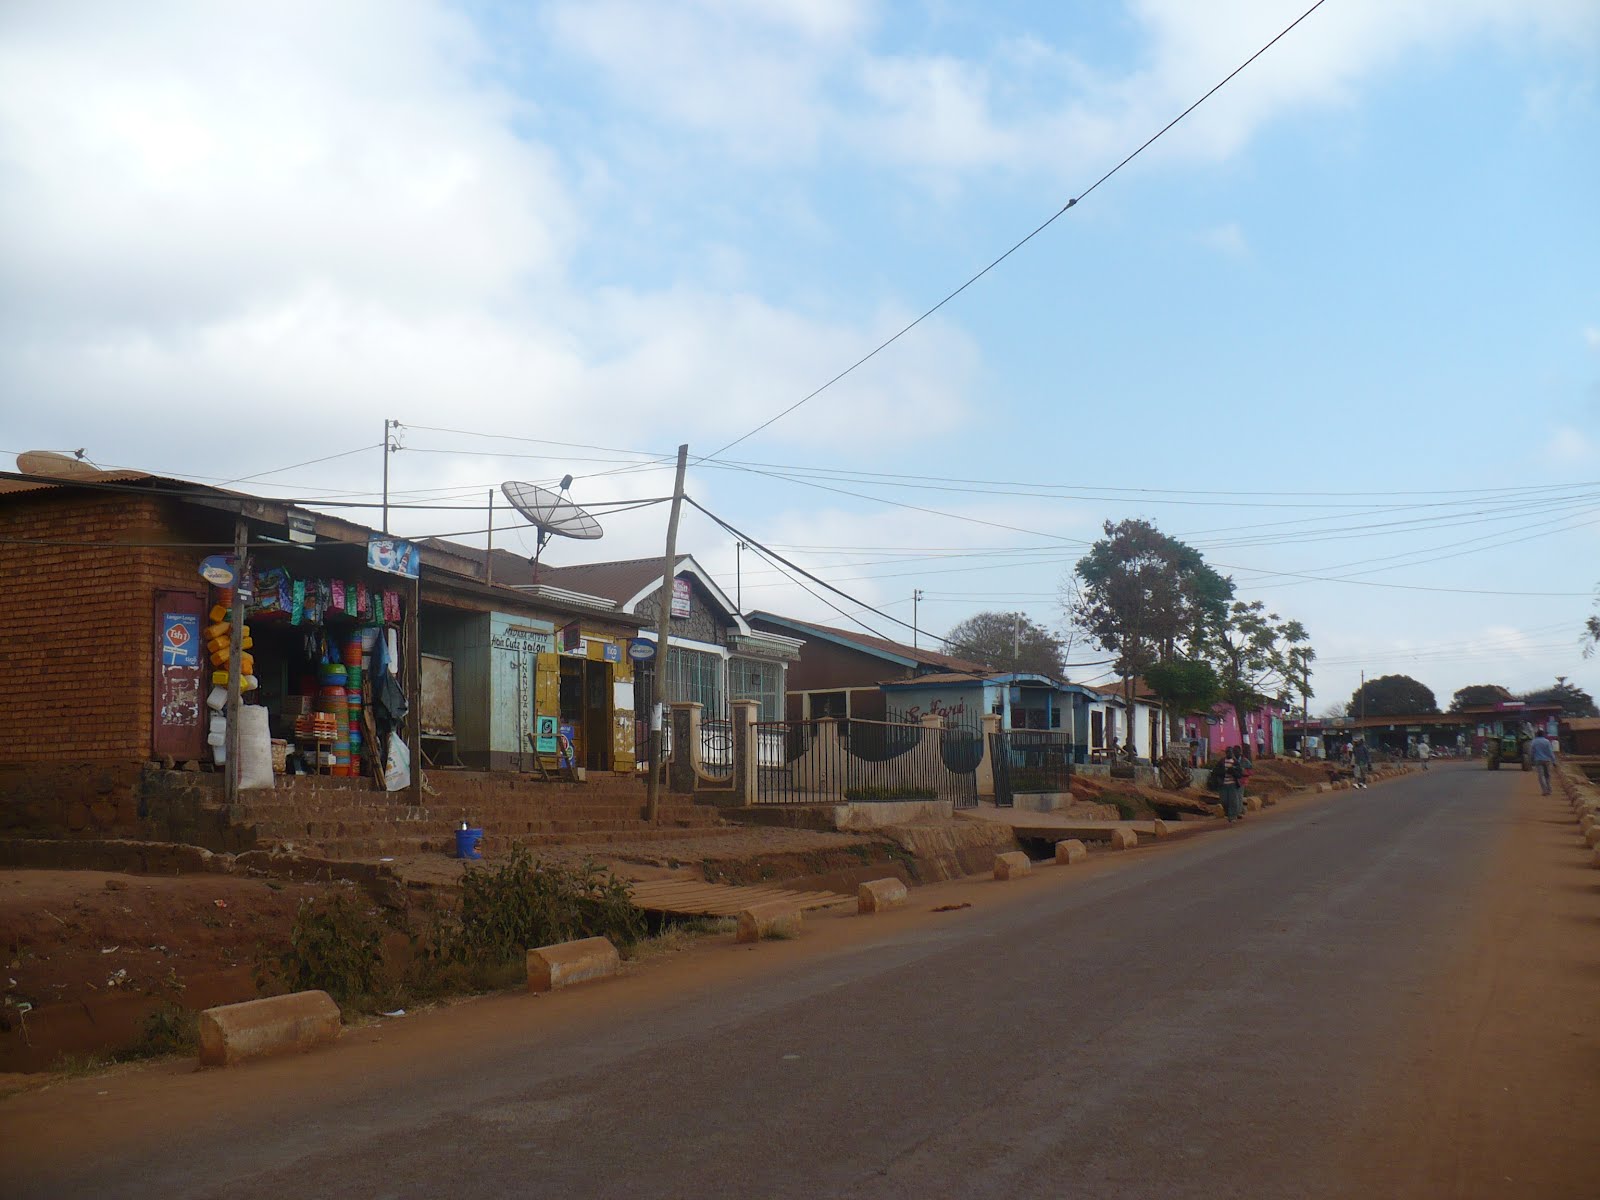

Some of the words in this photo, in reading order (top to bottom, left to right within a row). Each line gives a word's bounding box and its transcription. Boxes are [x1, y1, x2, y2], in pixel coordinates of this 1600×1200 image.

[170, 629, 183, 640] Tsh
[522, 640, 546, 654] Salon
[606, 645, 618, 659] tigo
